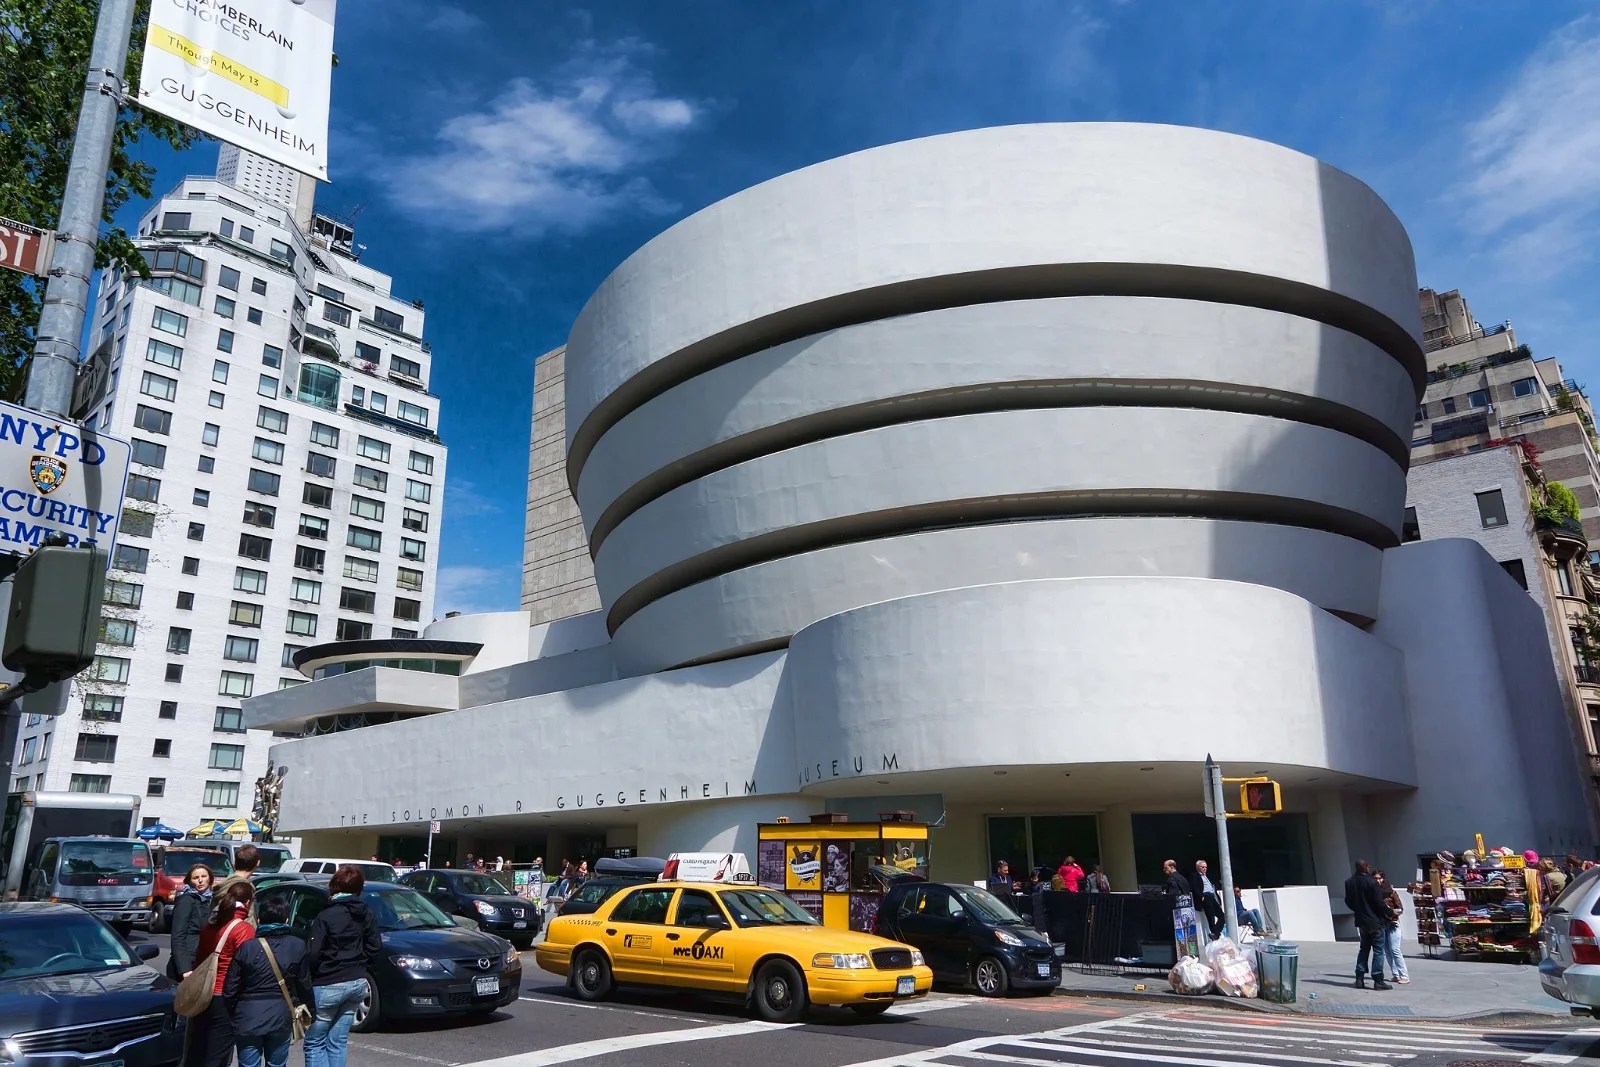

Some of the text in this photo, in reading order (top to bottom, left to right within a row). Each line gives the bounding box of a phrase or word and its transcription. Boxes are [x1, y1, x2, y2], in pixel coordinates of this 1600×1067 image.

[194, 0, 294, 51] AMBERLAIN
[167, 35, 259, 87] Through May 13
[160, 77, 316, 156] GUGGENHEIM
[0, 413, 106, 466] NYPD
[340, 813, 368, 826] THE
[392, 804, 484, 822] SOLOMON
[516, 800, 522, 812] R
[556, 780, 757, 809] GUGGENHEIM
[673, 942, 724, 960] NYC TAXI
